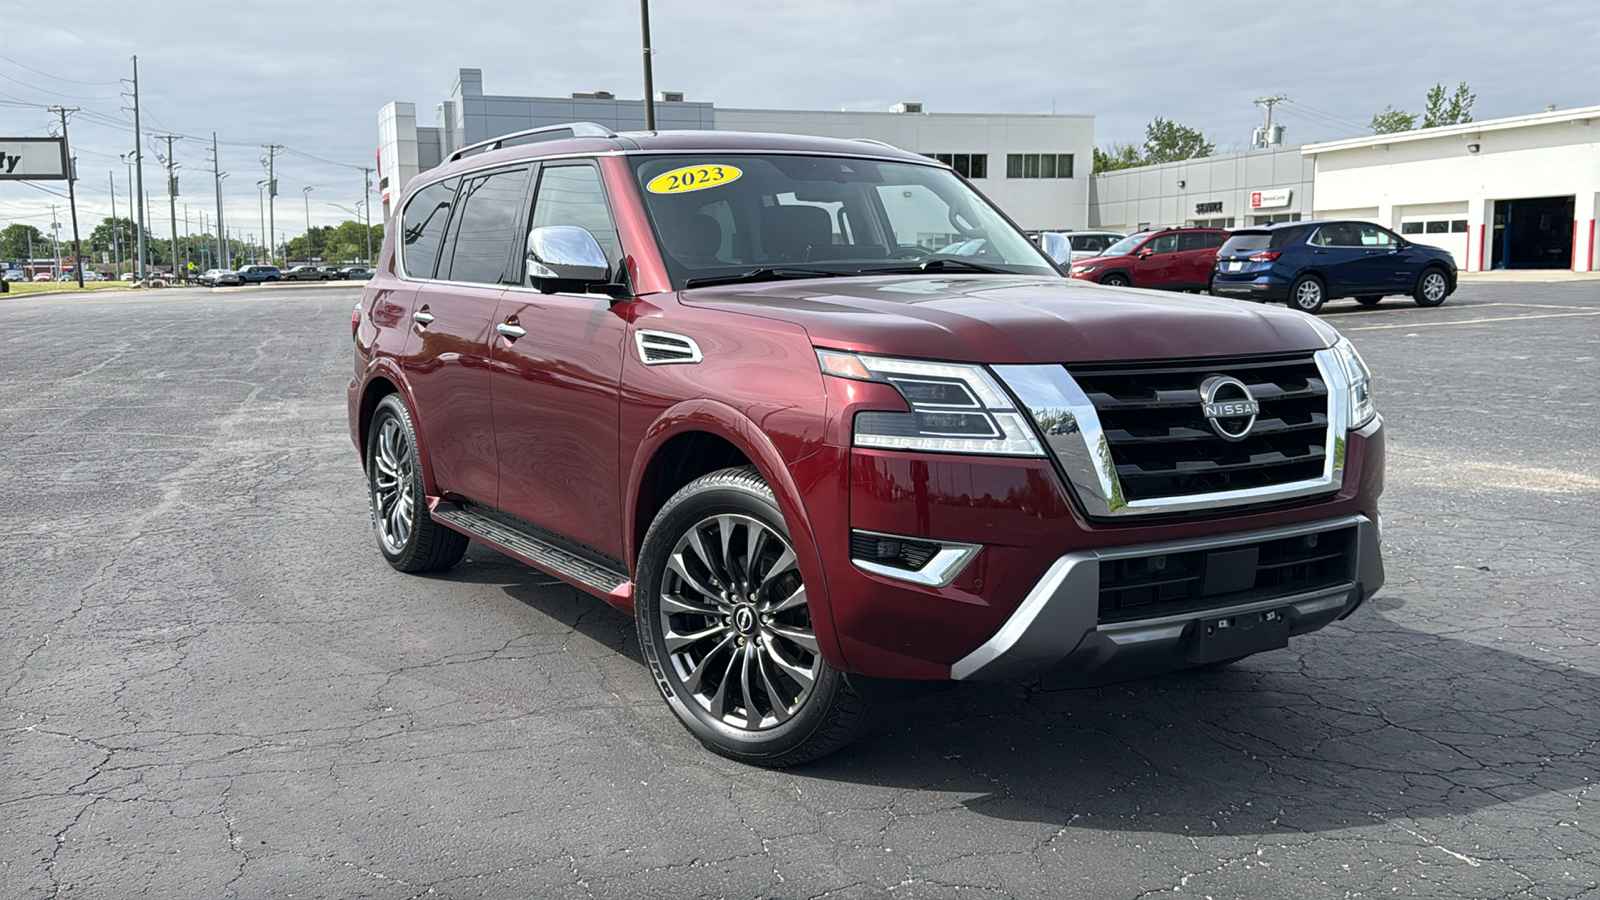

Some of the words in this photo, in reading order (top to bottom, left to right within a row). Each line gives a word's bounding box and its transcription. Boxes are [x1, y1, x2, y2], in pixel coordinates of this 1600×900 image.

[666, 167, 725, 190] 2023
[1195, 201, 1223, 215] SERVICE
[1205, 404, 1259, 416] NISSAN
